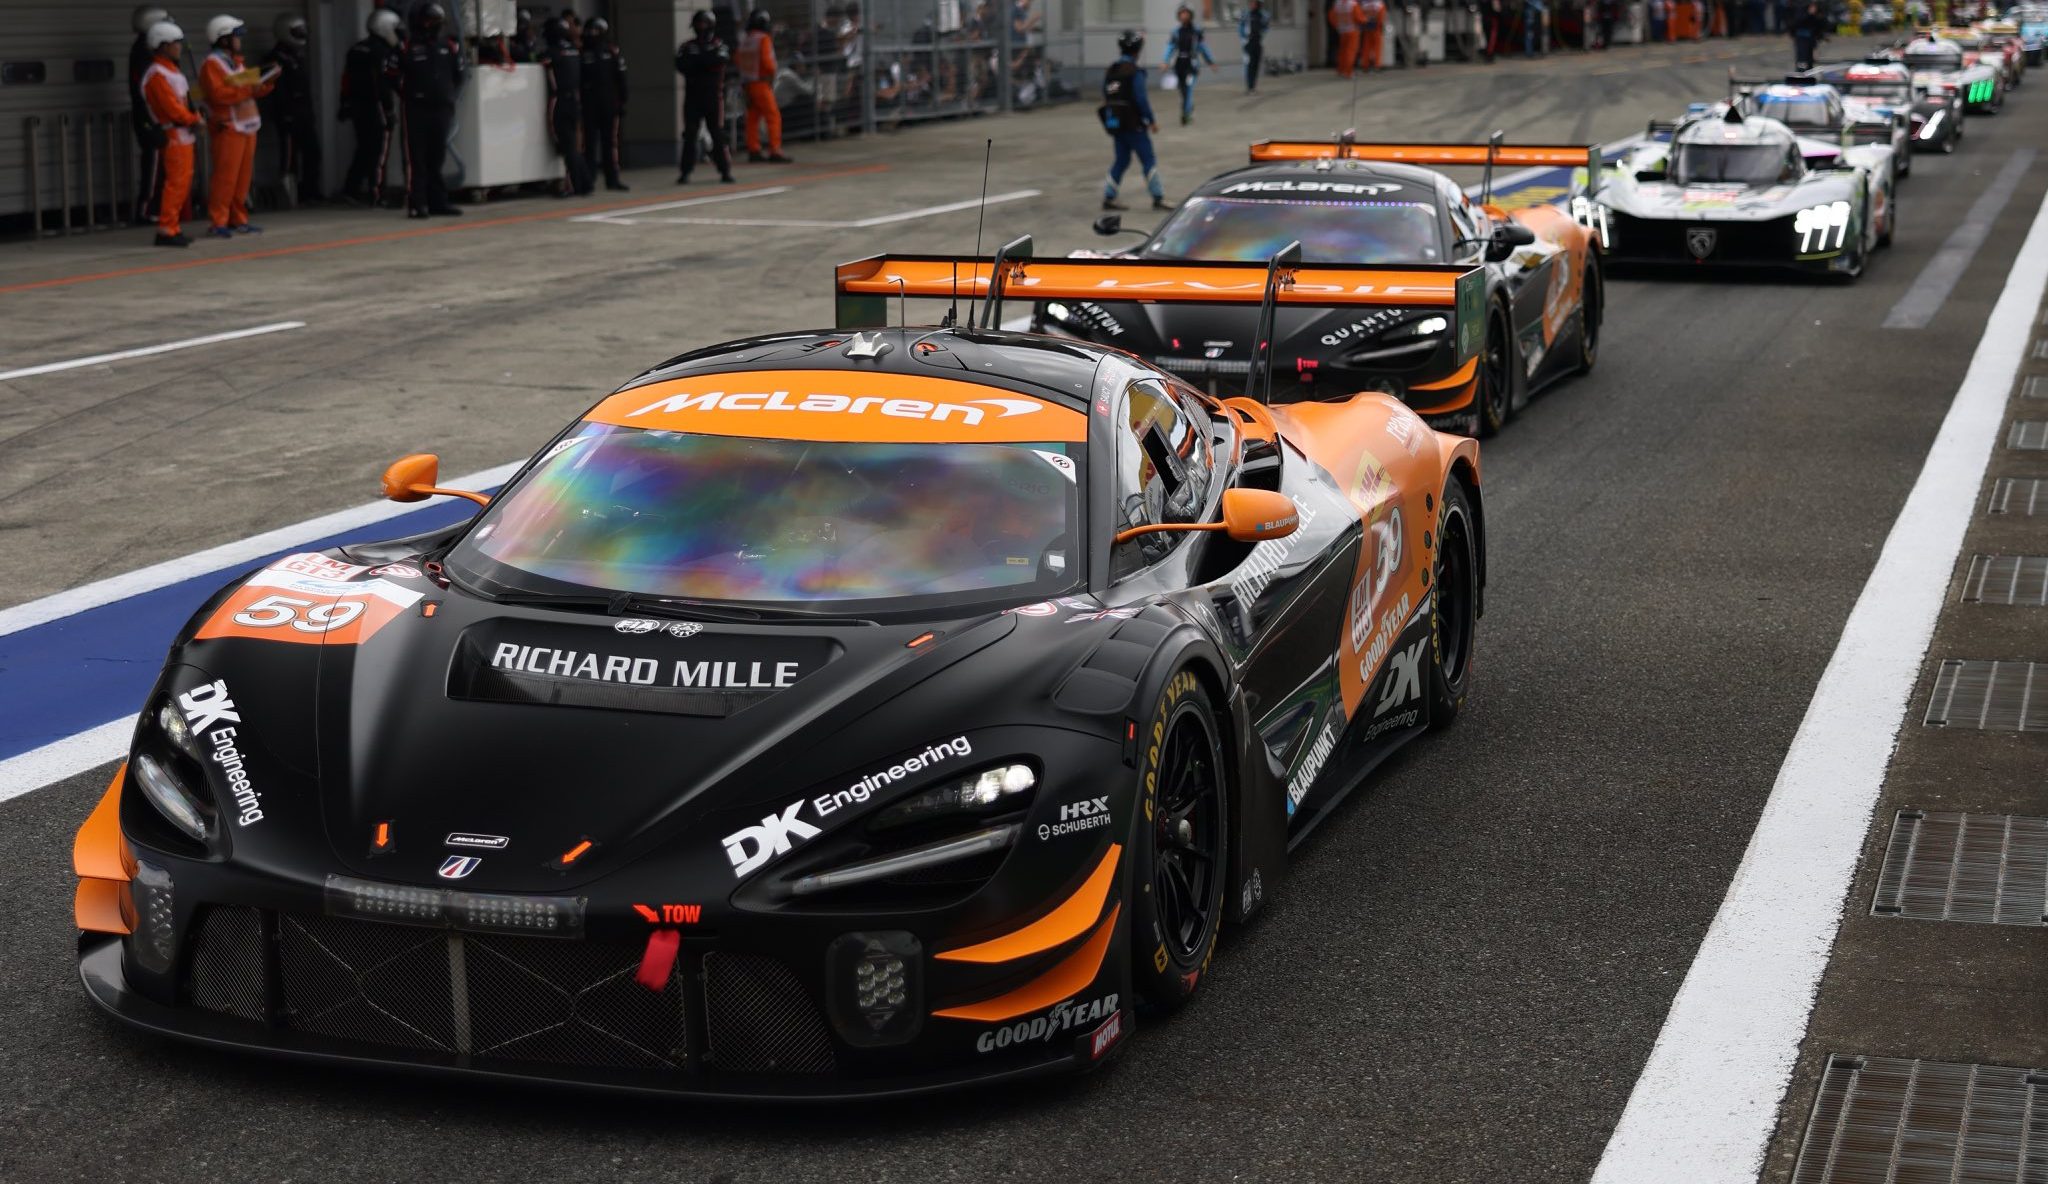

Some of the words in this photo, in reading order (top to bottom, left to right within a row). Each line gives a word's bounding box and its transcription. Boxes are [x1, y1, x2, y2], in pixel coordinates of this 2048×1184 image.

[1221, 181, 1402, 195] McLaren
[1321, 308, 1409, 345] QUANTU
[626, 391, 1042, 426] McLaren
[1376, 506, 1402, 594] 59
[231, 594, 368, 633] 59
[490, 642, 659, 685] RICHARD
[672, 661, 799, 688] MILLE
[1374, 636, 1428, 718] DK
[1364, 709, 1419, 742] Engineering
[179, 679, 241, 736] DK
[210, 727, 264, 826] Engineering
[1288, 722, 1337, 806] BLAUPUNKT
[721, 799, 823, 878] DK
[813, 735, 972, 817] Engineering
[1052, 813, 1111, 835] SCHUBERTH
[1060, 795, 1109, 821] HRX
[662, 904, 701, 923] TOW
[1094, 1015, 1121, 1054] MOTUL
